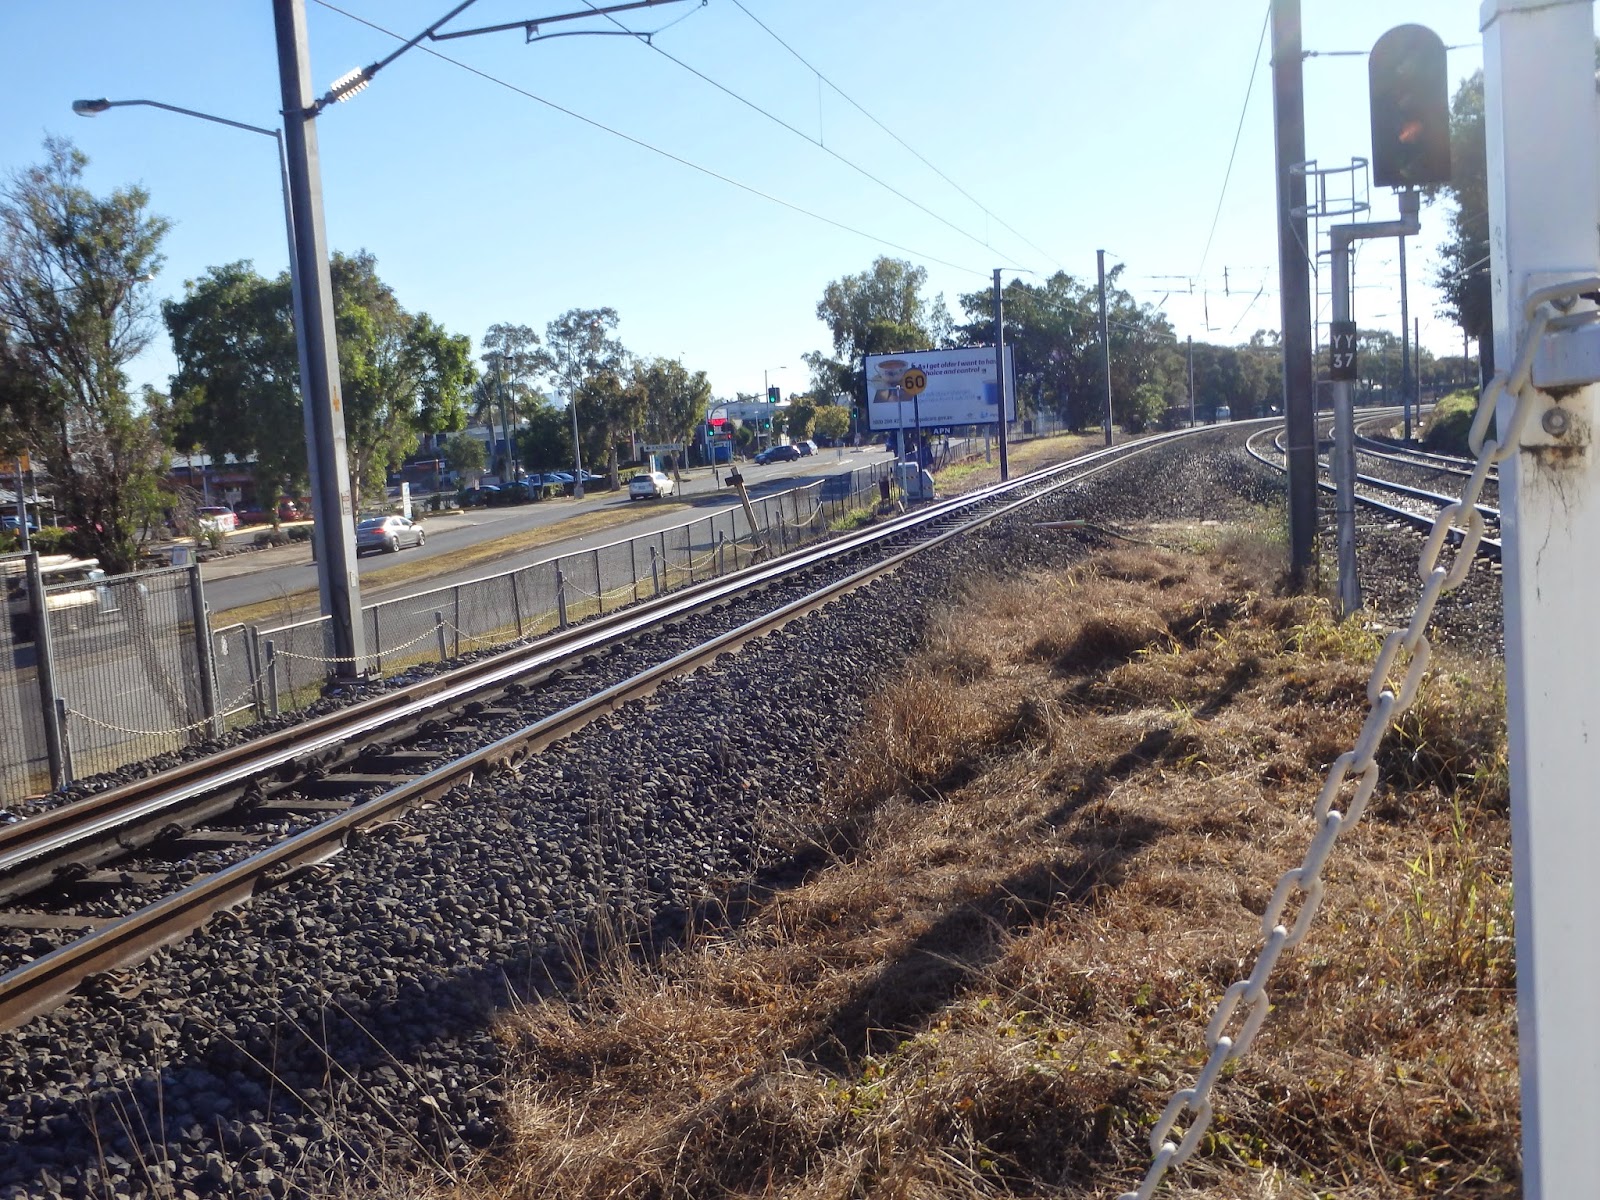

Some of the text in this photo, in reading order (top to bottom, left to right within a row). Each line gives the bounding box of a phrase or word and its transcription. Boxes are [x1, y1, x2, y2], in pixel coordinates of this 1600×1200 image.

[1333, 334, 1354, 349] YY
[1333, 352, 1354, 368] 37
[957, 366, 980, 374] control
[904, 375, 925, 389] 60
[933, 427, 951, 435] APN
